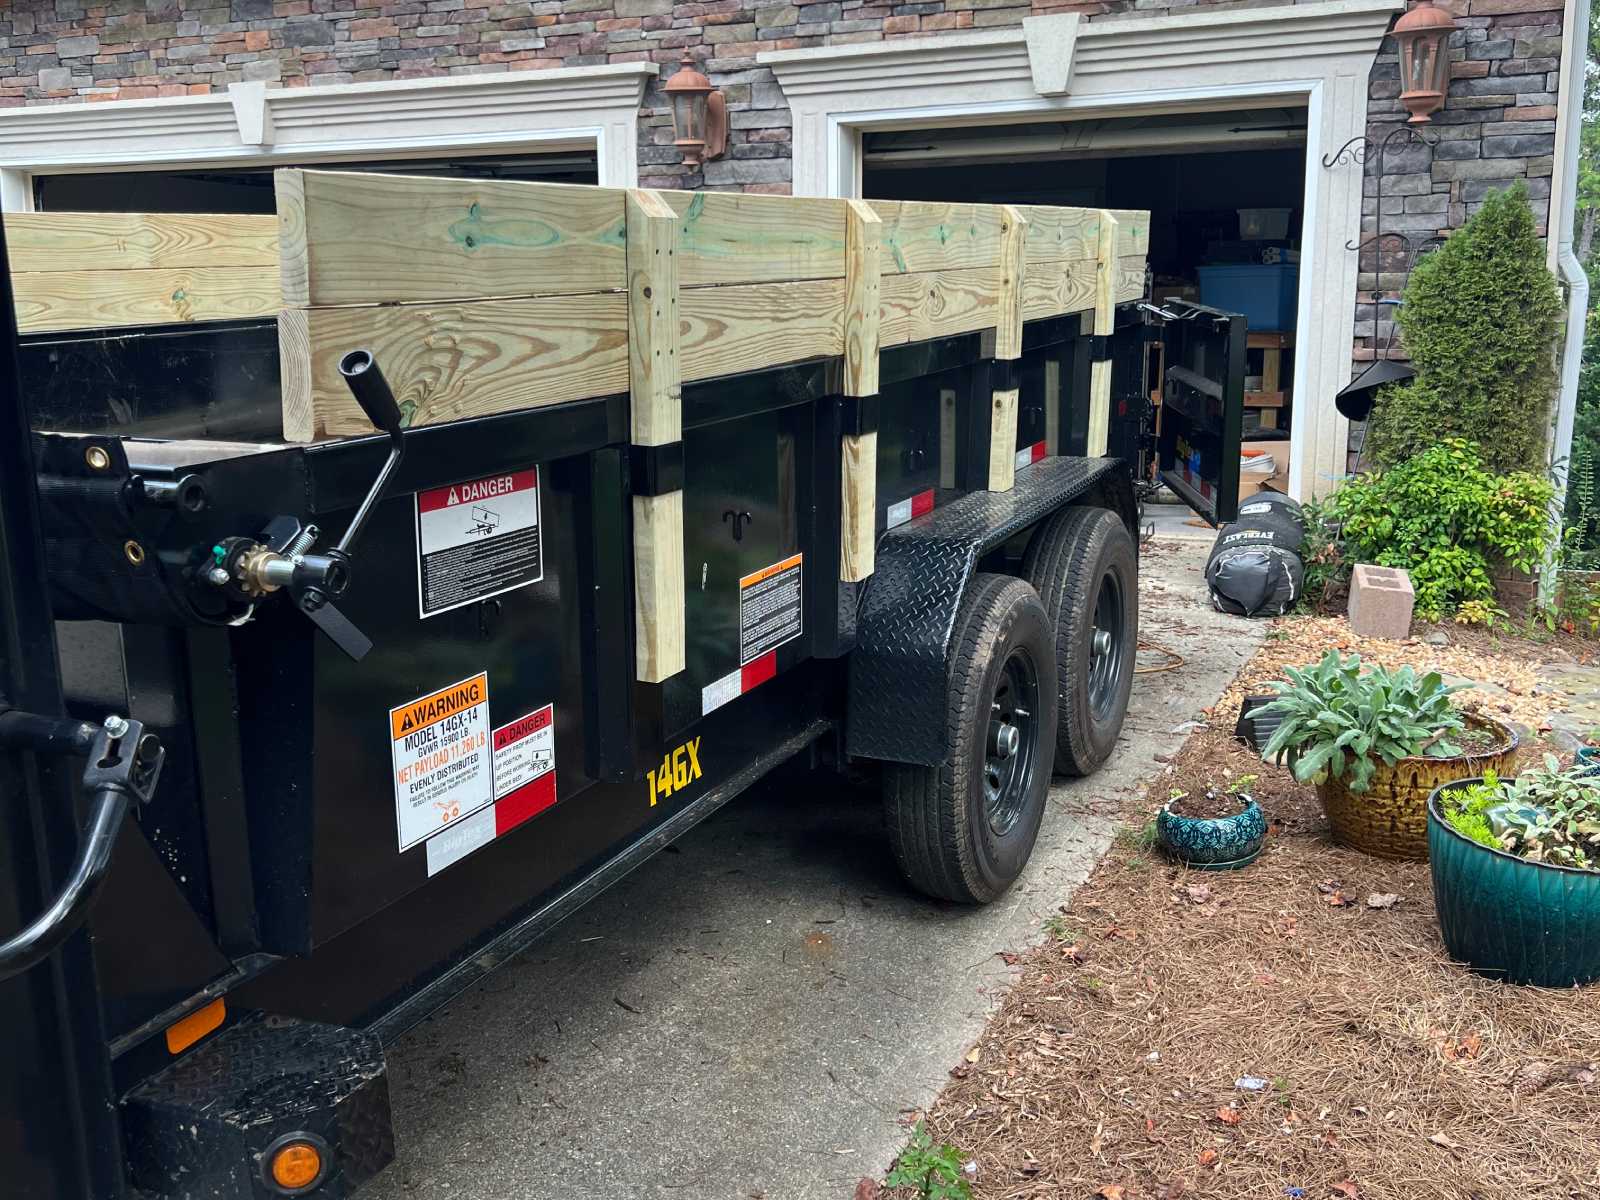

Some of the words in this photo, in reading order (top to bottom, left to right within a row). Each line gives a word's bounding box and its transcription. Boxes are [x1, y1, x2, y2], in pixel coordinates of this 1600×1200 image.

[462, 476, 514, 502] DANGER
[1223, 530, 1275, 545] EVERLAST
[413, 684, 480, 725] WARNING
[404, 726, 438, 752] MODEL
[440, 707, 478, 736] 14GX-14
[418, 740, 439, 758] GVWR
[440, 731, 460, 748] 15900
[509, 713, 546, 741] DANGER
[398, 764, 413, 784] NET
[414, 748, 449, 777] PAYLOAD
[410, 773, 436, 794] EVENLY
[436, 753, 480, 781] DISTRIBUTED
[646, 735, 703, 808] 14GX
